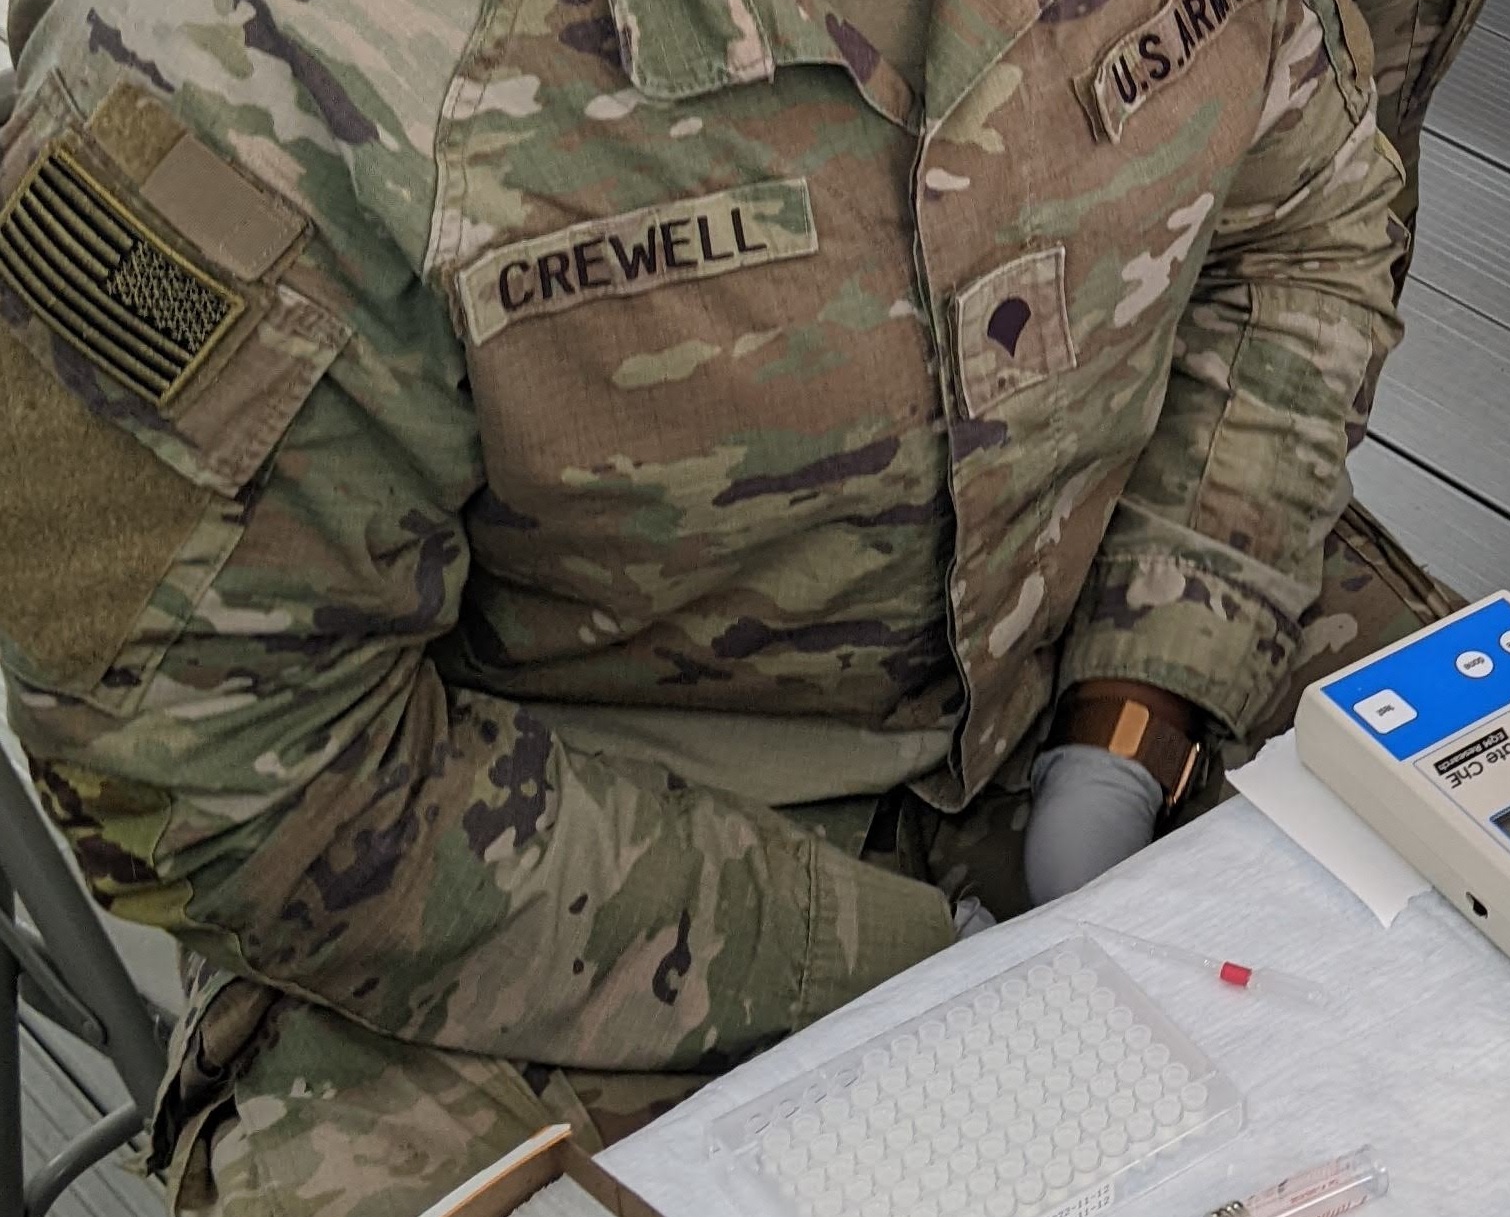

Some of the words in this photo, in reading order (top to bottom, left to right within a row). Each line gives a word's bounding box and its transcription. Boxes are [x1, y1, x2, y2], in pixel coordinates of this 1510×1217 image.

[499, 207, 768, 312] CREWELL
[1437, 743, 1483, 772] Research
[1445, 760, 1484, 790] ChE
